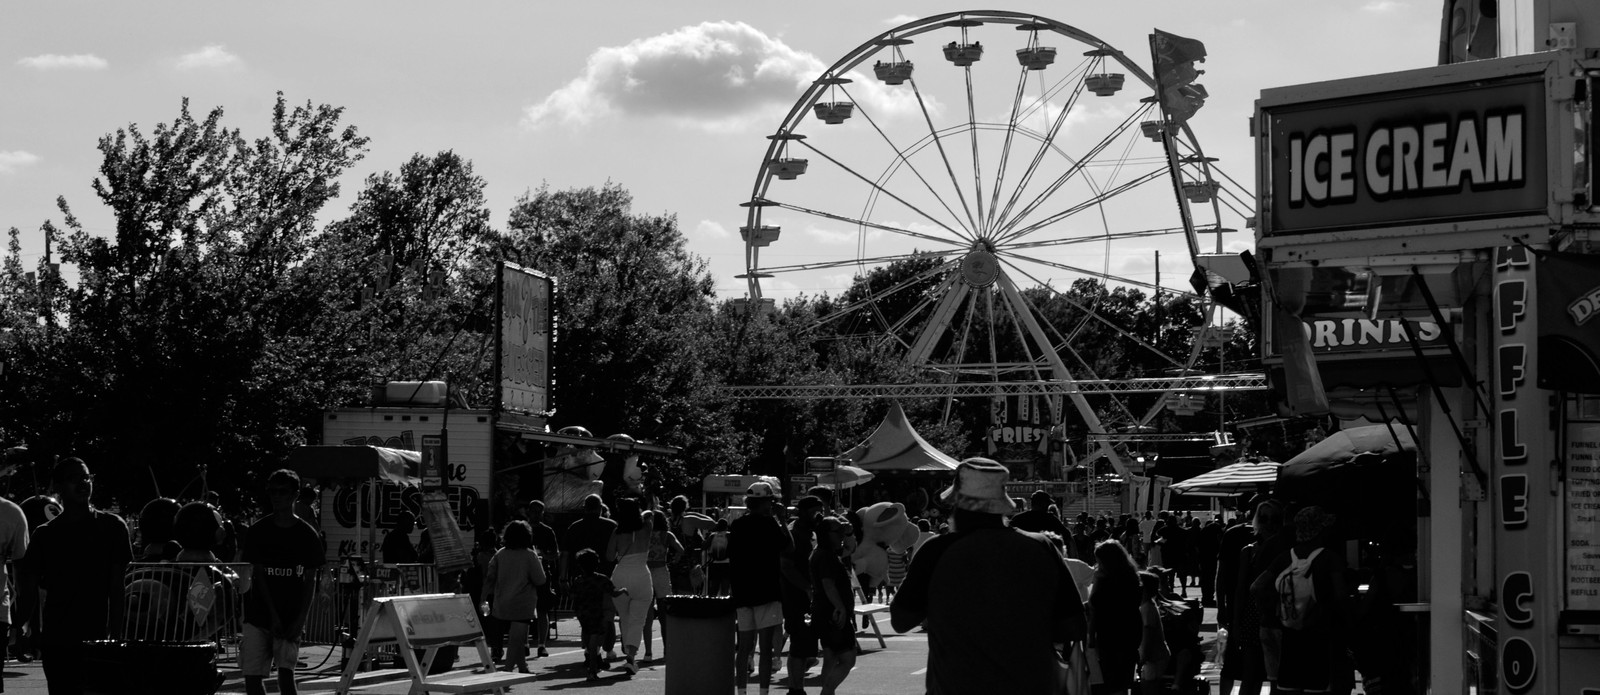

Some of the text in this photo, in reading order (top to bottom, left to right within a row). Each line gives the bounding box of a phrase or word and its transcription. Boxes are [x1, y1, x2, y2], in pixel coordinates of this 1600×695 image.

[1289, 112, 1523, 203] ICE CREAM
[992, 426, 1043, 444] FRIES
[800, 483, 807, 494] 3
[1571, 539, 1590, 547] SODA
